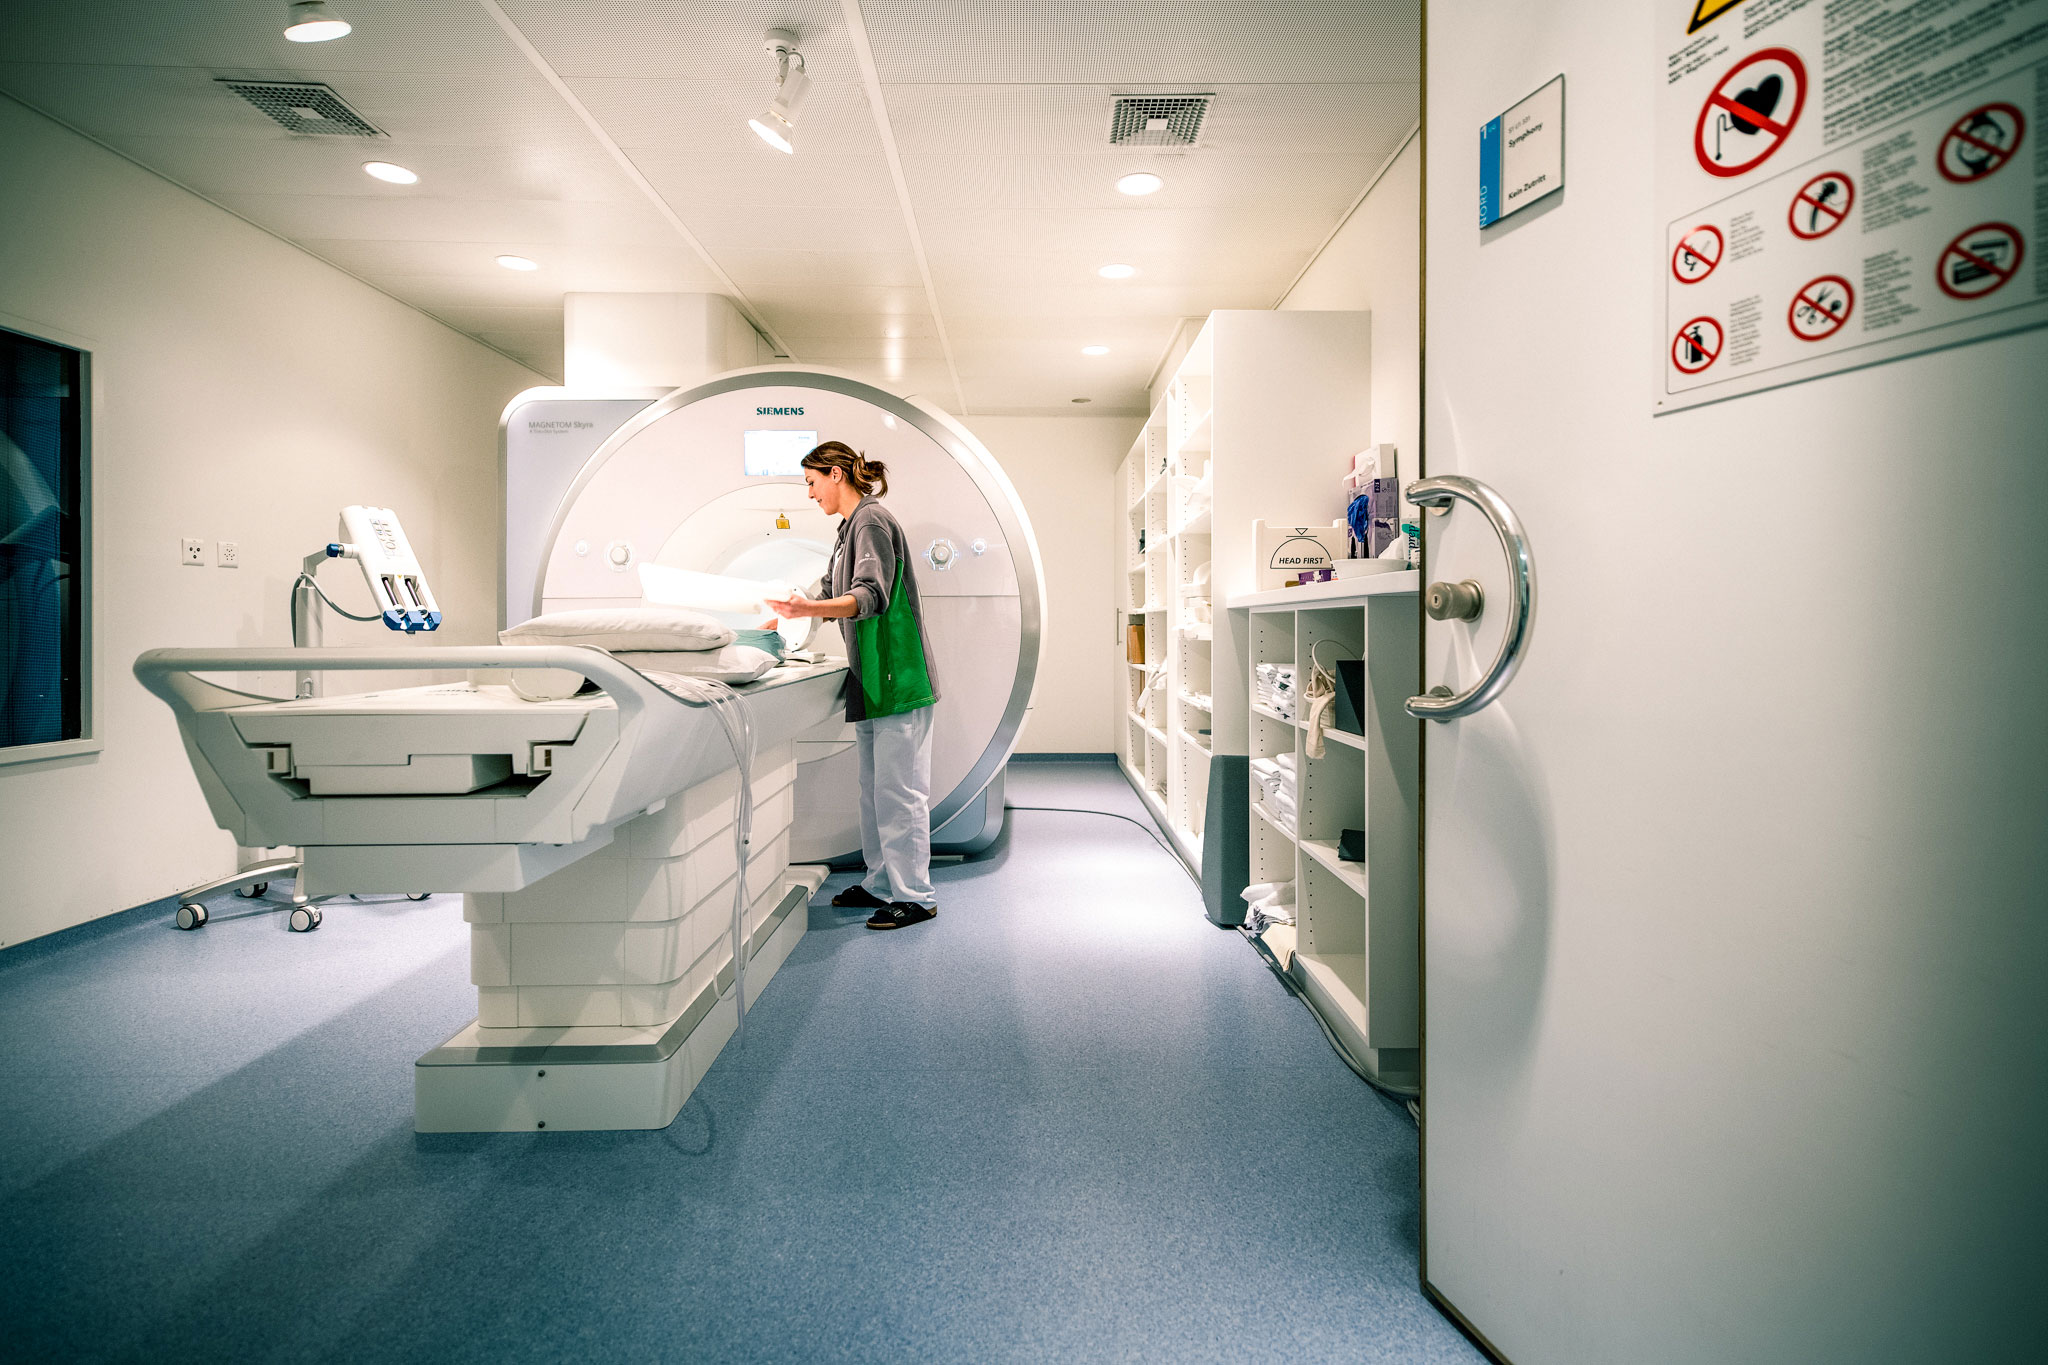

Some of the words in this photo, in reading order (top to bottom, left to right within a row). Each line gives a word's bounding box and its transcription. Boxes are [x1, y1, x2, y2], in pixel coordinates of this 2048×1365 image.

[1480, 125, 1487, 139] 1
[1508, 122, 1543, 148] Symphony
[1508, 188, 1522, 200] Kein
[1523, 174, 1546, 192] Zutritt
[1480, 185, 1488, 228] NORD
[756, 407, 805, 416] SIEMENS
[529, 421, 572, 429] MAGNETOM
[574, 421, 593, 429] Skyra
[1278, 557, 1301, 565] HEAD
[1302, 557, 1325, 565] FIRST
